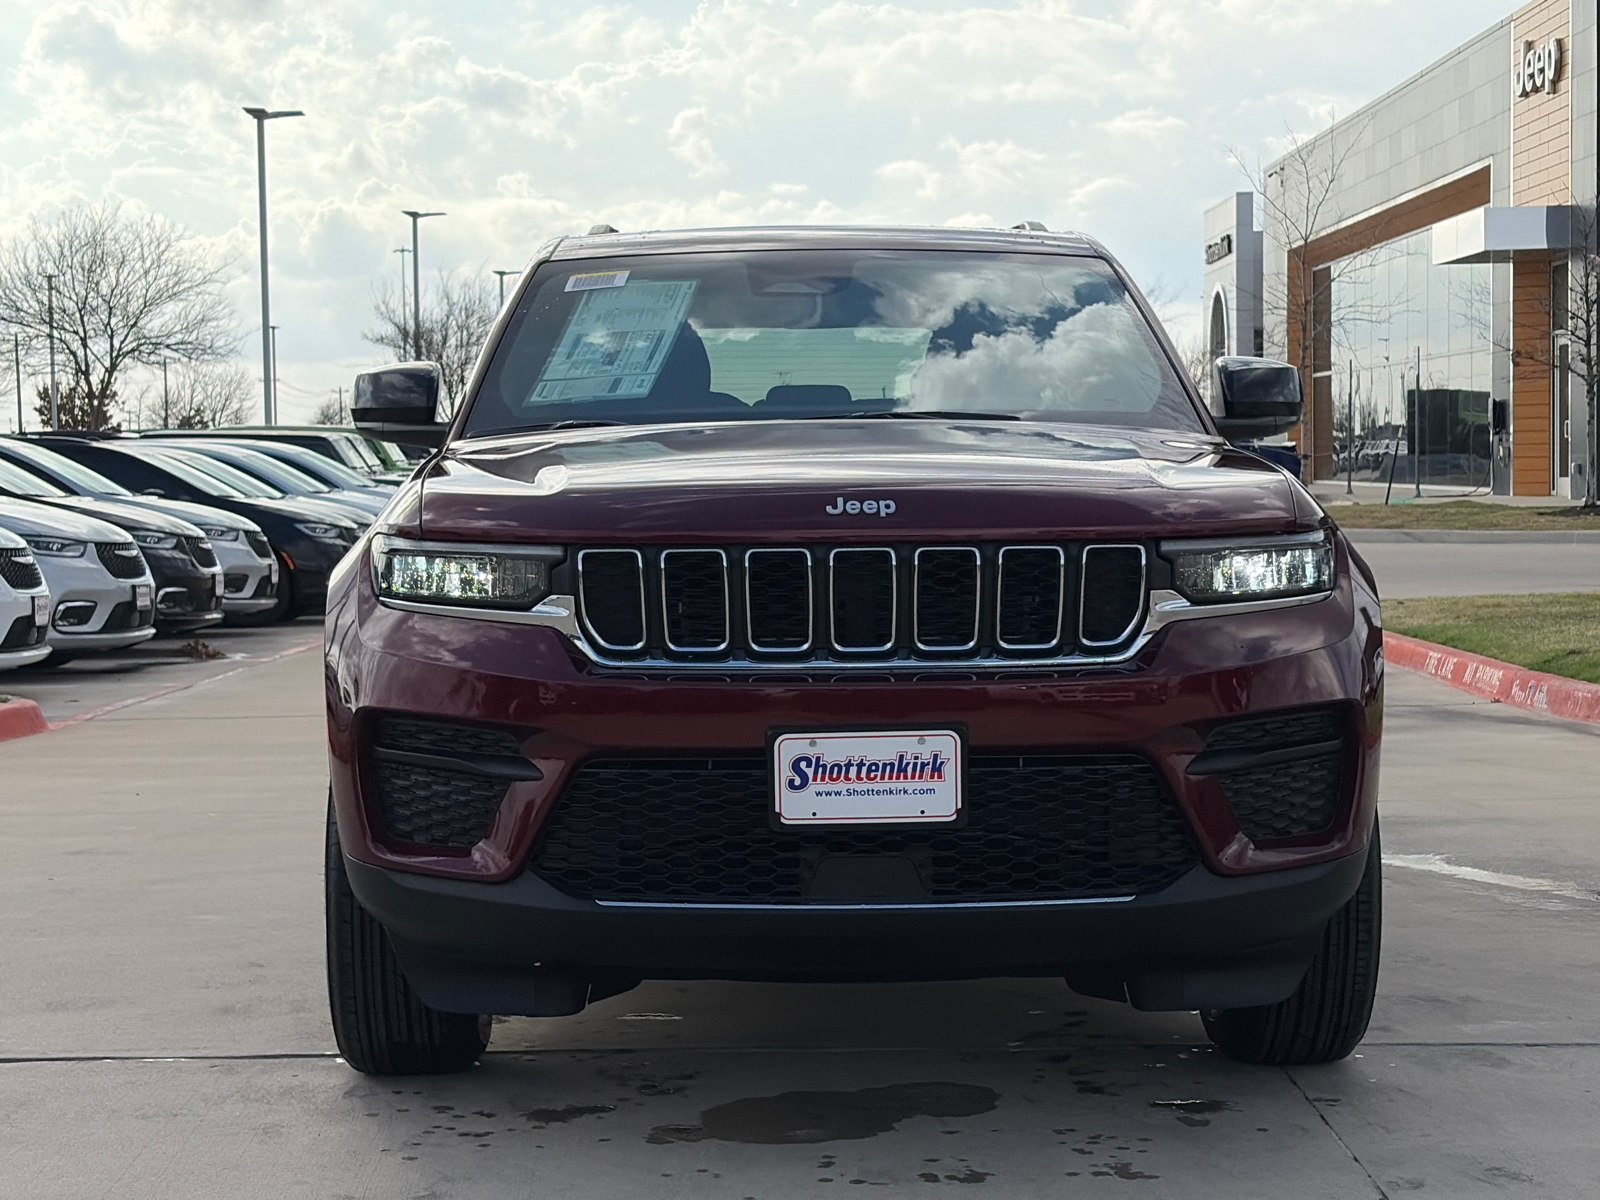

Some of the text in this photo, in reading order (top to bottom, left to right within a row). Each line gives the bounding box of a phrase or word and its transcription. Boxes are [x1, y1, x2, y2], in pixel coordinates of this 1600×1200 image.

[1514, 37, 1559, 96] Jeep
[825, 496, 896, 518] Jeep
[785, 750, 950, 793] Shottenkirk
[814, 786, 936, 798] www.Shottenkirk.com
